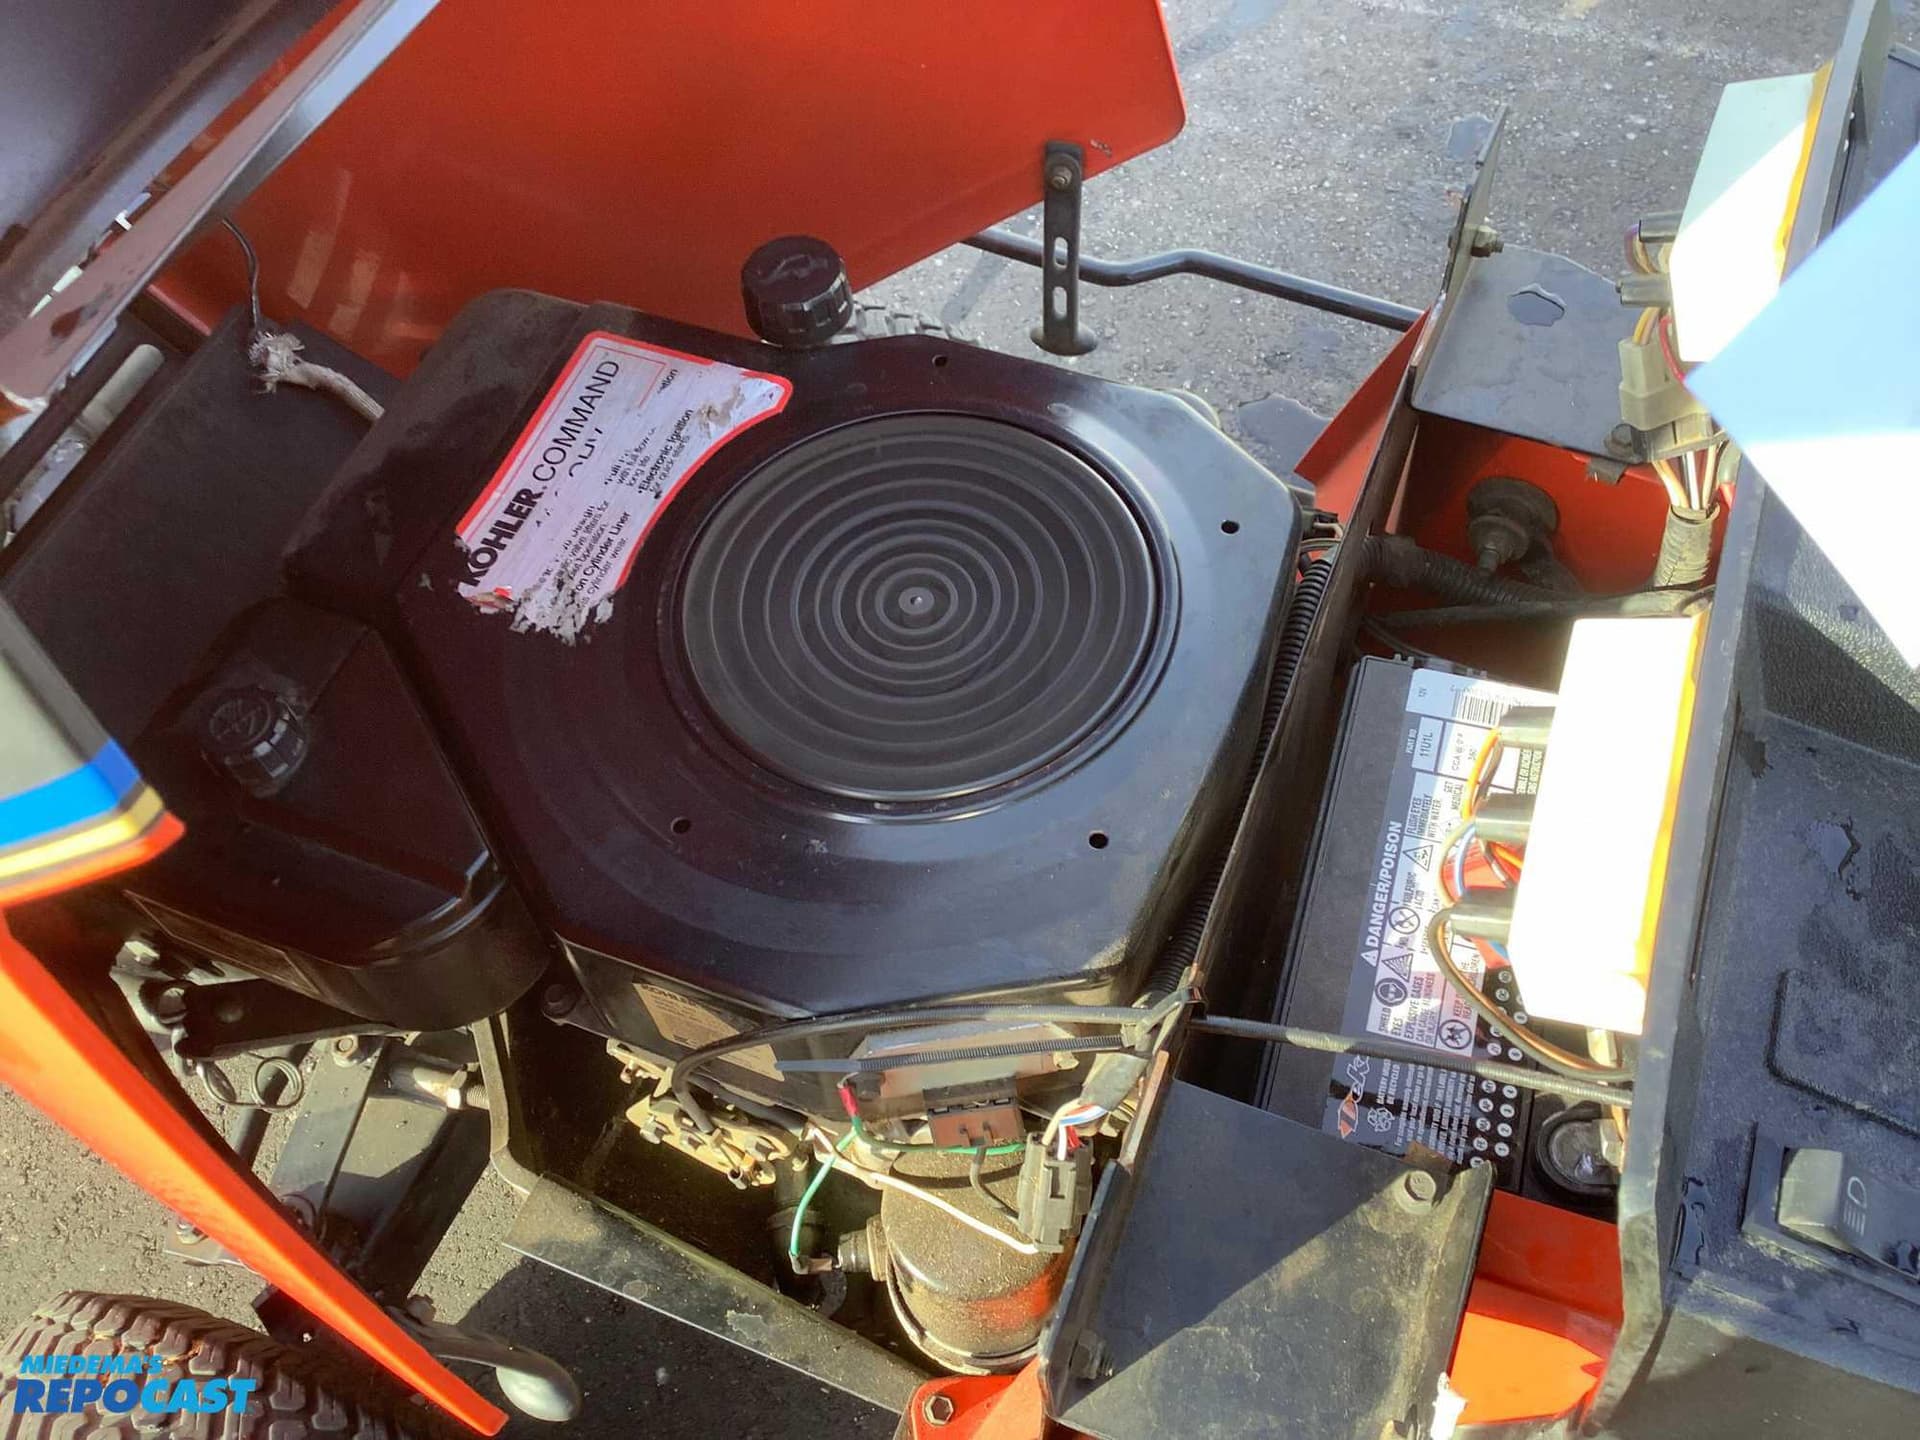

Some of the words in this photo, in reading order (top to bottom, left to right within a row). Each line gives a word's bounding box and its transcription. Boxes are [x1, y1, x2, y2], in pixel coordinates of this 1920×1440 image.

[532, 360, 620, 483] COMMAND
[666, 407, 695, 444] Ignition
[583, 535, 615, 577] Cylinder
[609, 510, 629, 535] Liner
[1418, 730, 1434, 758] 11U1L
[1410, 797, 1421, 812] EYES
[1449, 782, 1463, 810] MEDICAL
[1415, 793, 1433, 836] IMMEDIATELY
[1365, 820, 1402, 948] DANGER/POISON
[1410, 975, 1424, 999] GASES
[1377, 1006, 1392, 1033] SHIELD
[1390, 1017, 1403, 1036] EYES
[1402, 999, 1420, 1039] EXPLOSIVE
